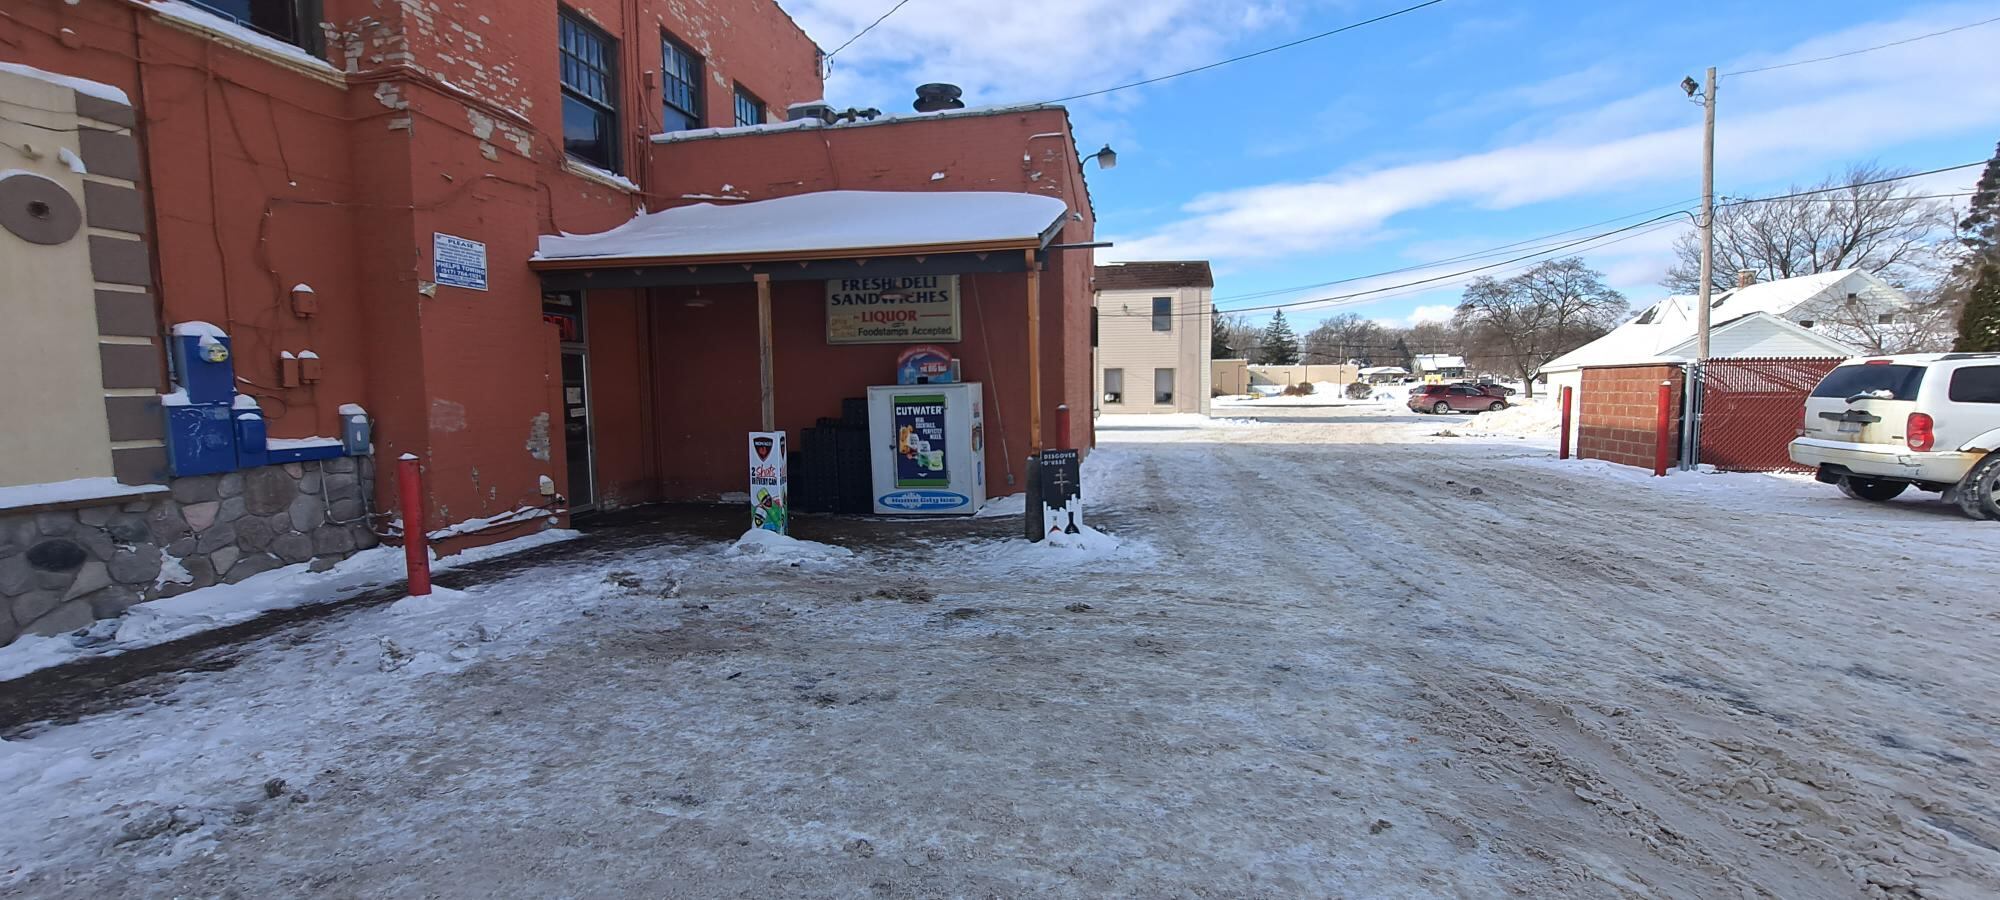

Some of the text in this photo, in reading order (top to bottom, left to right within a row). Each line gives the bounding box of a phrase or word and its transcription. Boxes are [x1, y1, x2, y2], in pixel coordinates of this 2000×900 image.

[447, 239, 473, 249] PLEASE
[462, 265, 485, 276] TOWING
[841, 276, 937, 291] FRESH DELI
[861, 310, 918, 324] LIQUOR
[858, 326, 952, 337] Foodstamps Accepted
[896, 406, 942, 416] CUTWATER
[751, 467, 756, 477] 2
